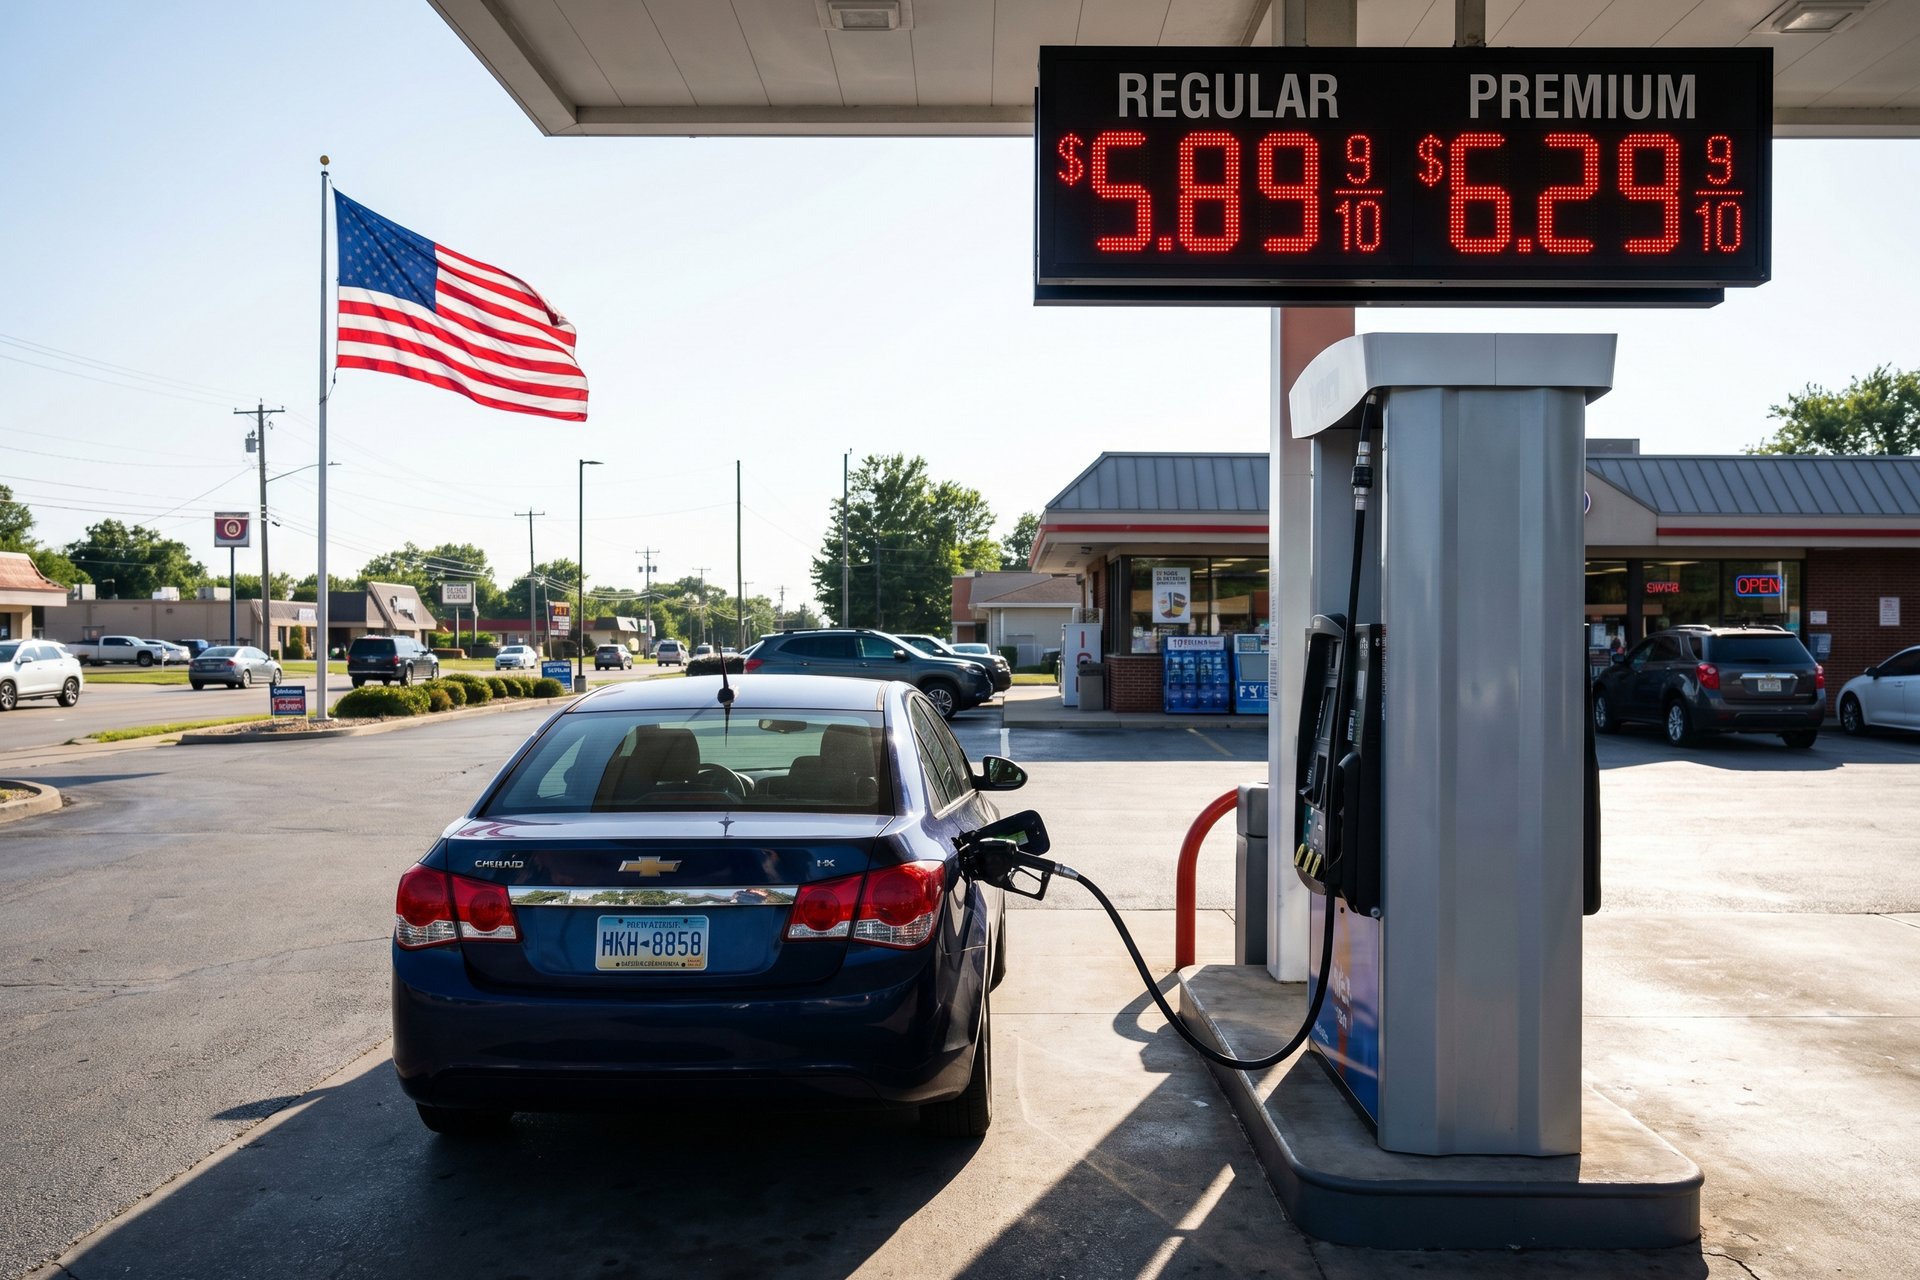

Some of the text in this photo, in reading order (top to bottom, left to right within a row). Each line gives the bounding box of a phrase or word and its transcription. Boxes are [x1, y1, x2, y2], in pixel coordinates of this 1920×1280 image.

[1118, 73, 1339, 119] REGULAR
[1469, 74, 1697, 120] PREMIUM
[1058, 132, 1320, 252] $5.89
[1418, 133, 1680, 253] $6.29
[1738, 578, 1780, 593] OPEN
